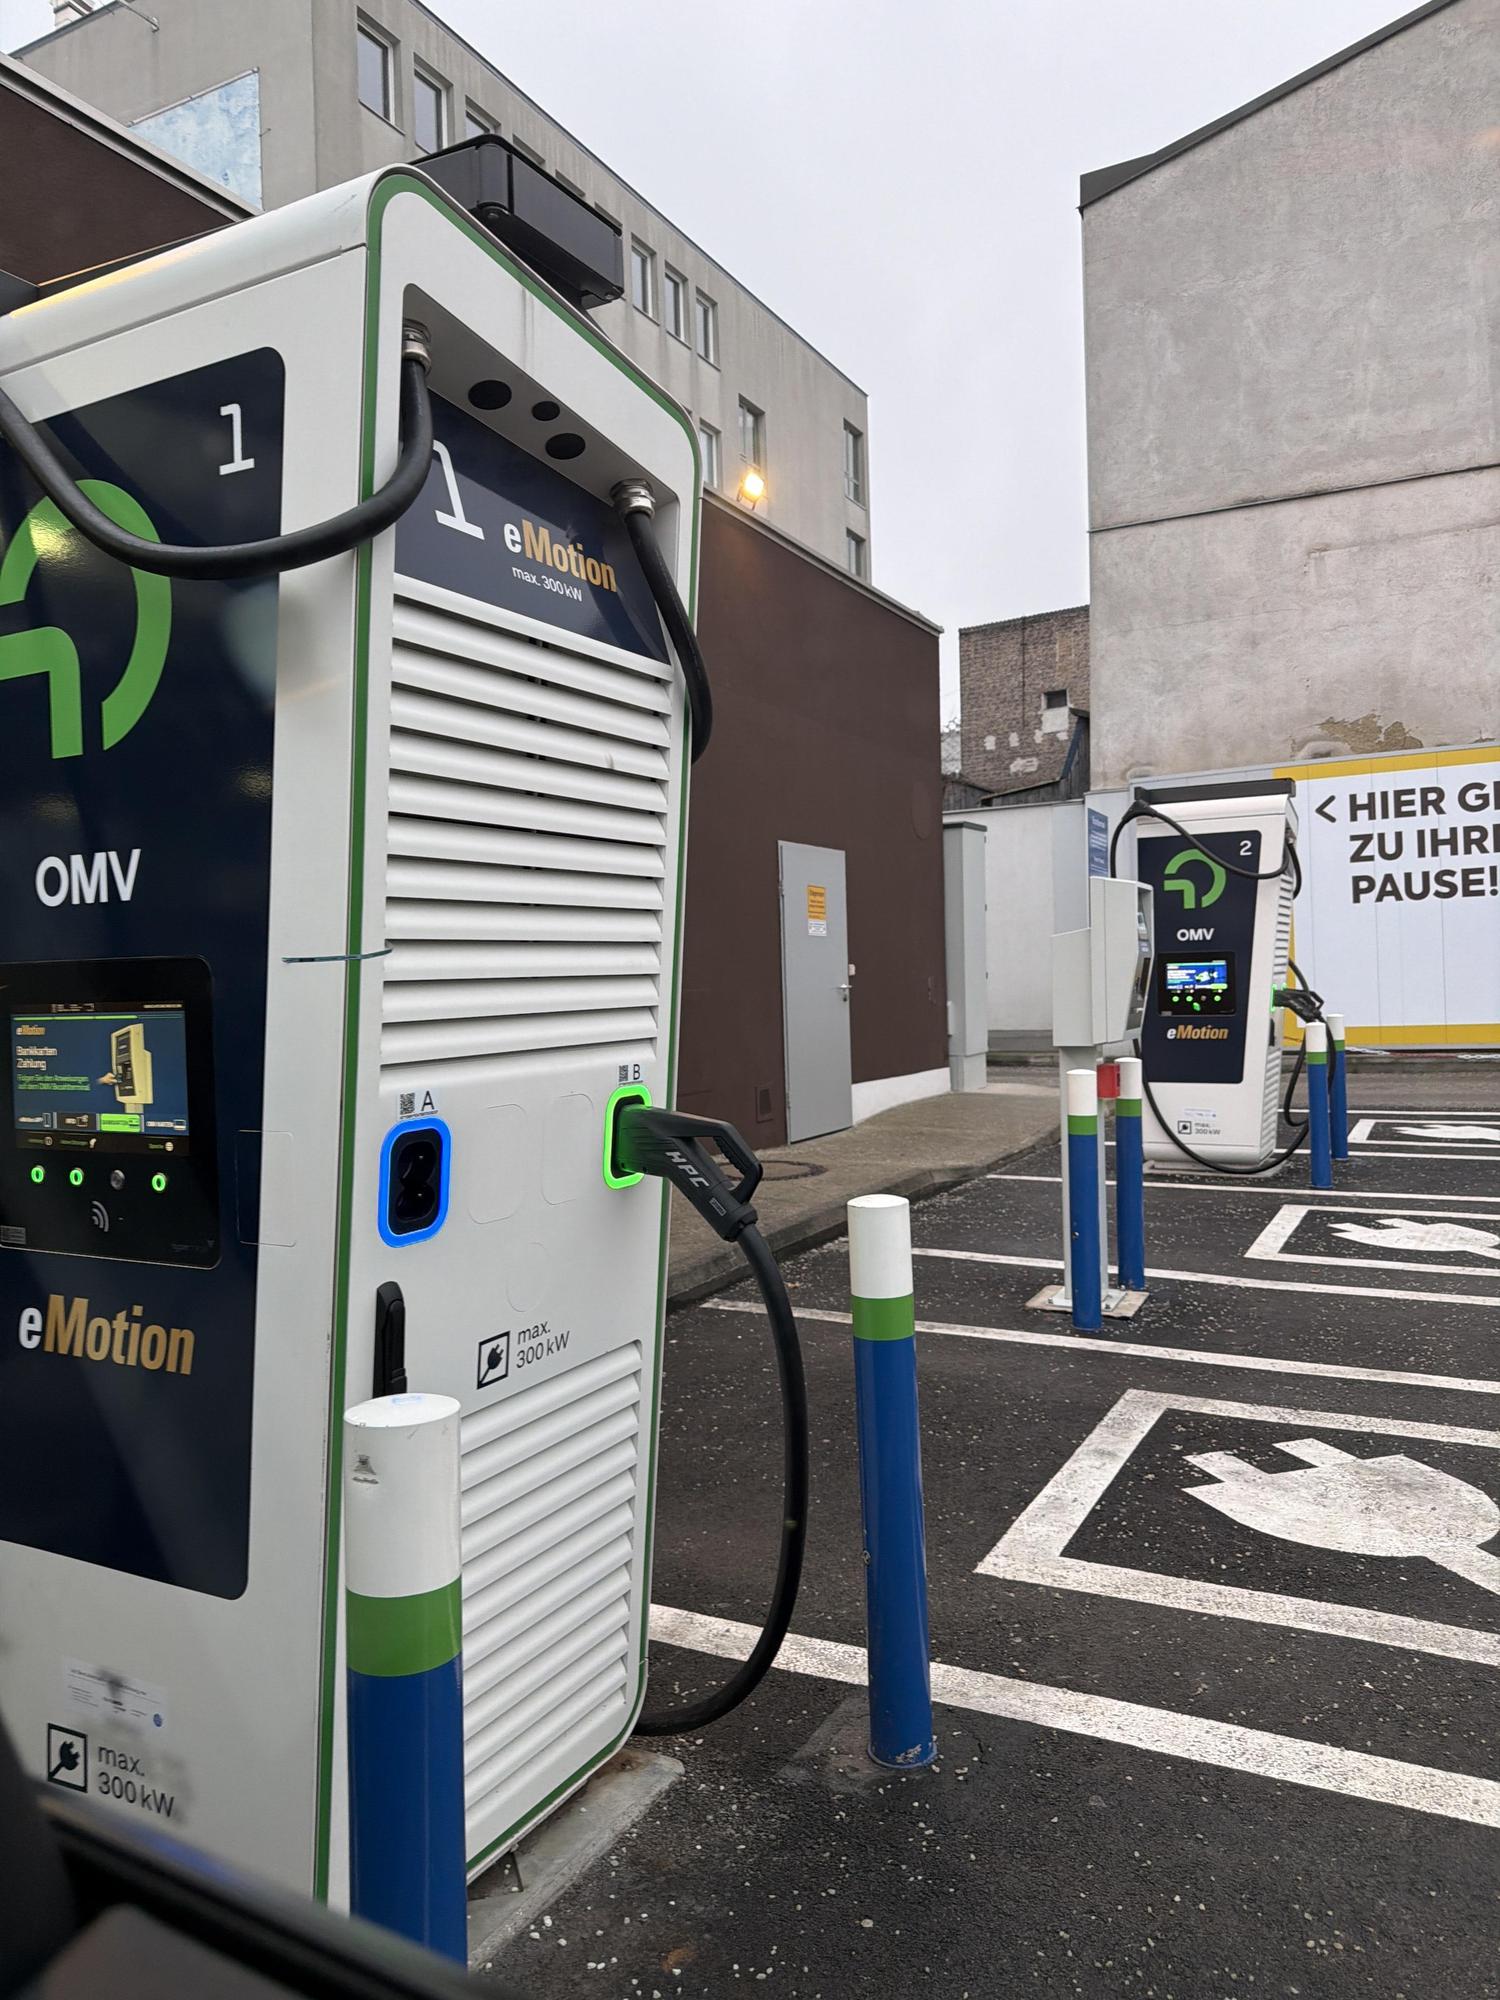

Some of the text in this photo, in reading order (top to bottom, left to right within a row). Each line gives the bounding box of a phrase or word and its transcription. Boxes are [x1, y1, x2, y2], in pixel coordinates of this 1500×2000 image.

[219, 403, 255, 475] 1
[433, 439, 485, 540] 1
[503, 519, 618, 593] eMotion
[511, 566, 539, 586] max.
[541, 575, 566, 596] 300
[1349, 780, 1500, 822] HIER G
[1239, 840, 1253, 856] 2
[1349, 823, 1500, 863] ZU IHR
[35, 848, 142, 907] OMV
[1352, 865, 1499, 904] PAUSE!
[1176, 928, 1215, 942] OMV
[1166, 1024, 1230, 1040] eMotion
[632, 1063, 641, 1081] B
[421, 1090, 435, 1112] A
[665, 1151, 710, 1188] HPC
[18, 1293, 196, 1376] eMotion
[516, 1330, 570, 1369] 300 kW
[517, 1321, 551, 1345] max.
[98, 1746, 145, 1777] max.
[98, 1771, 175, 1818] 300 kW
